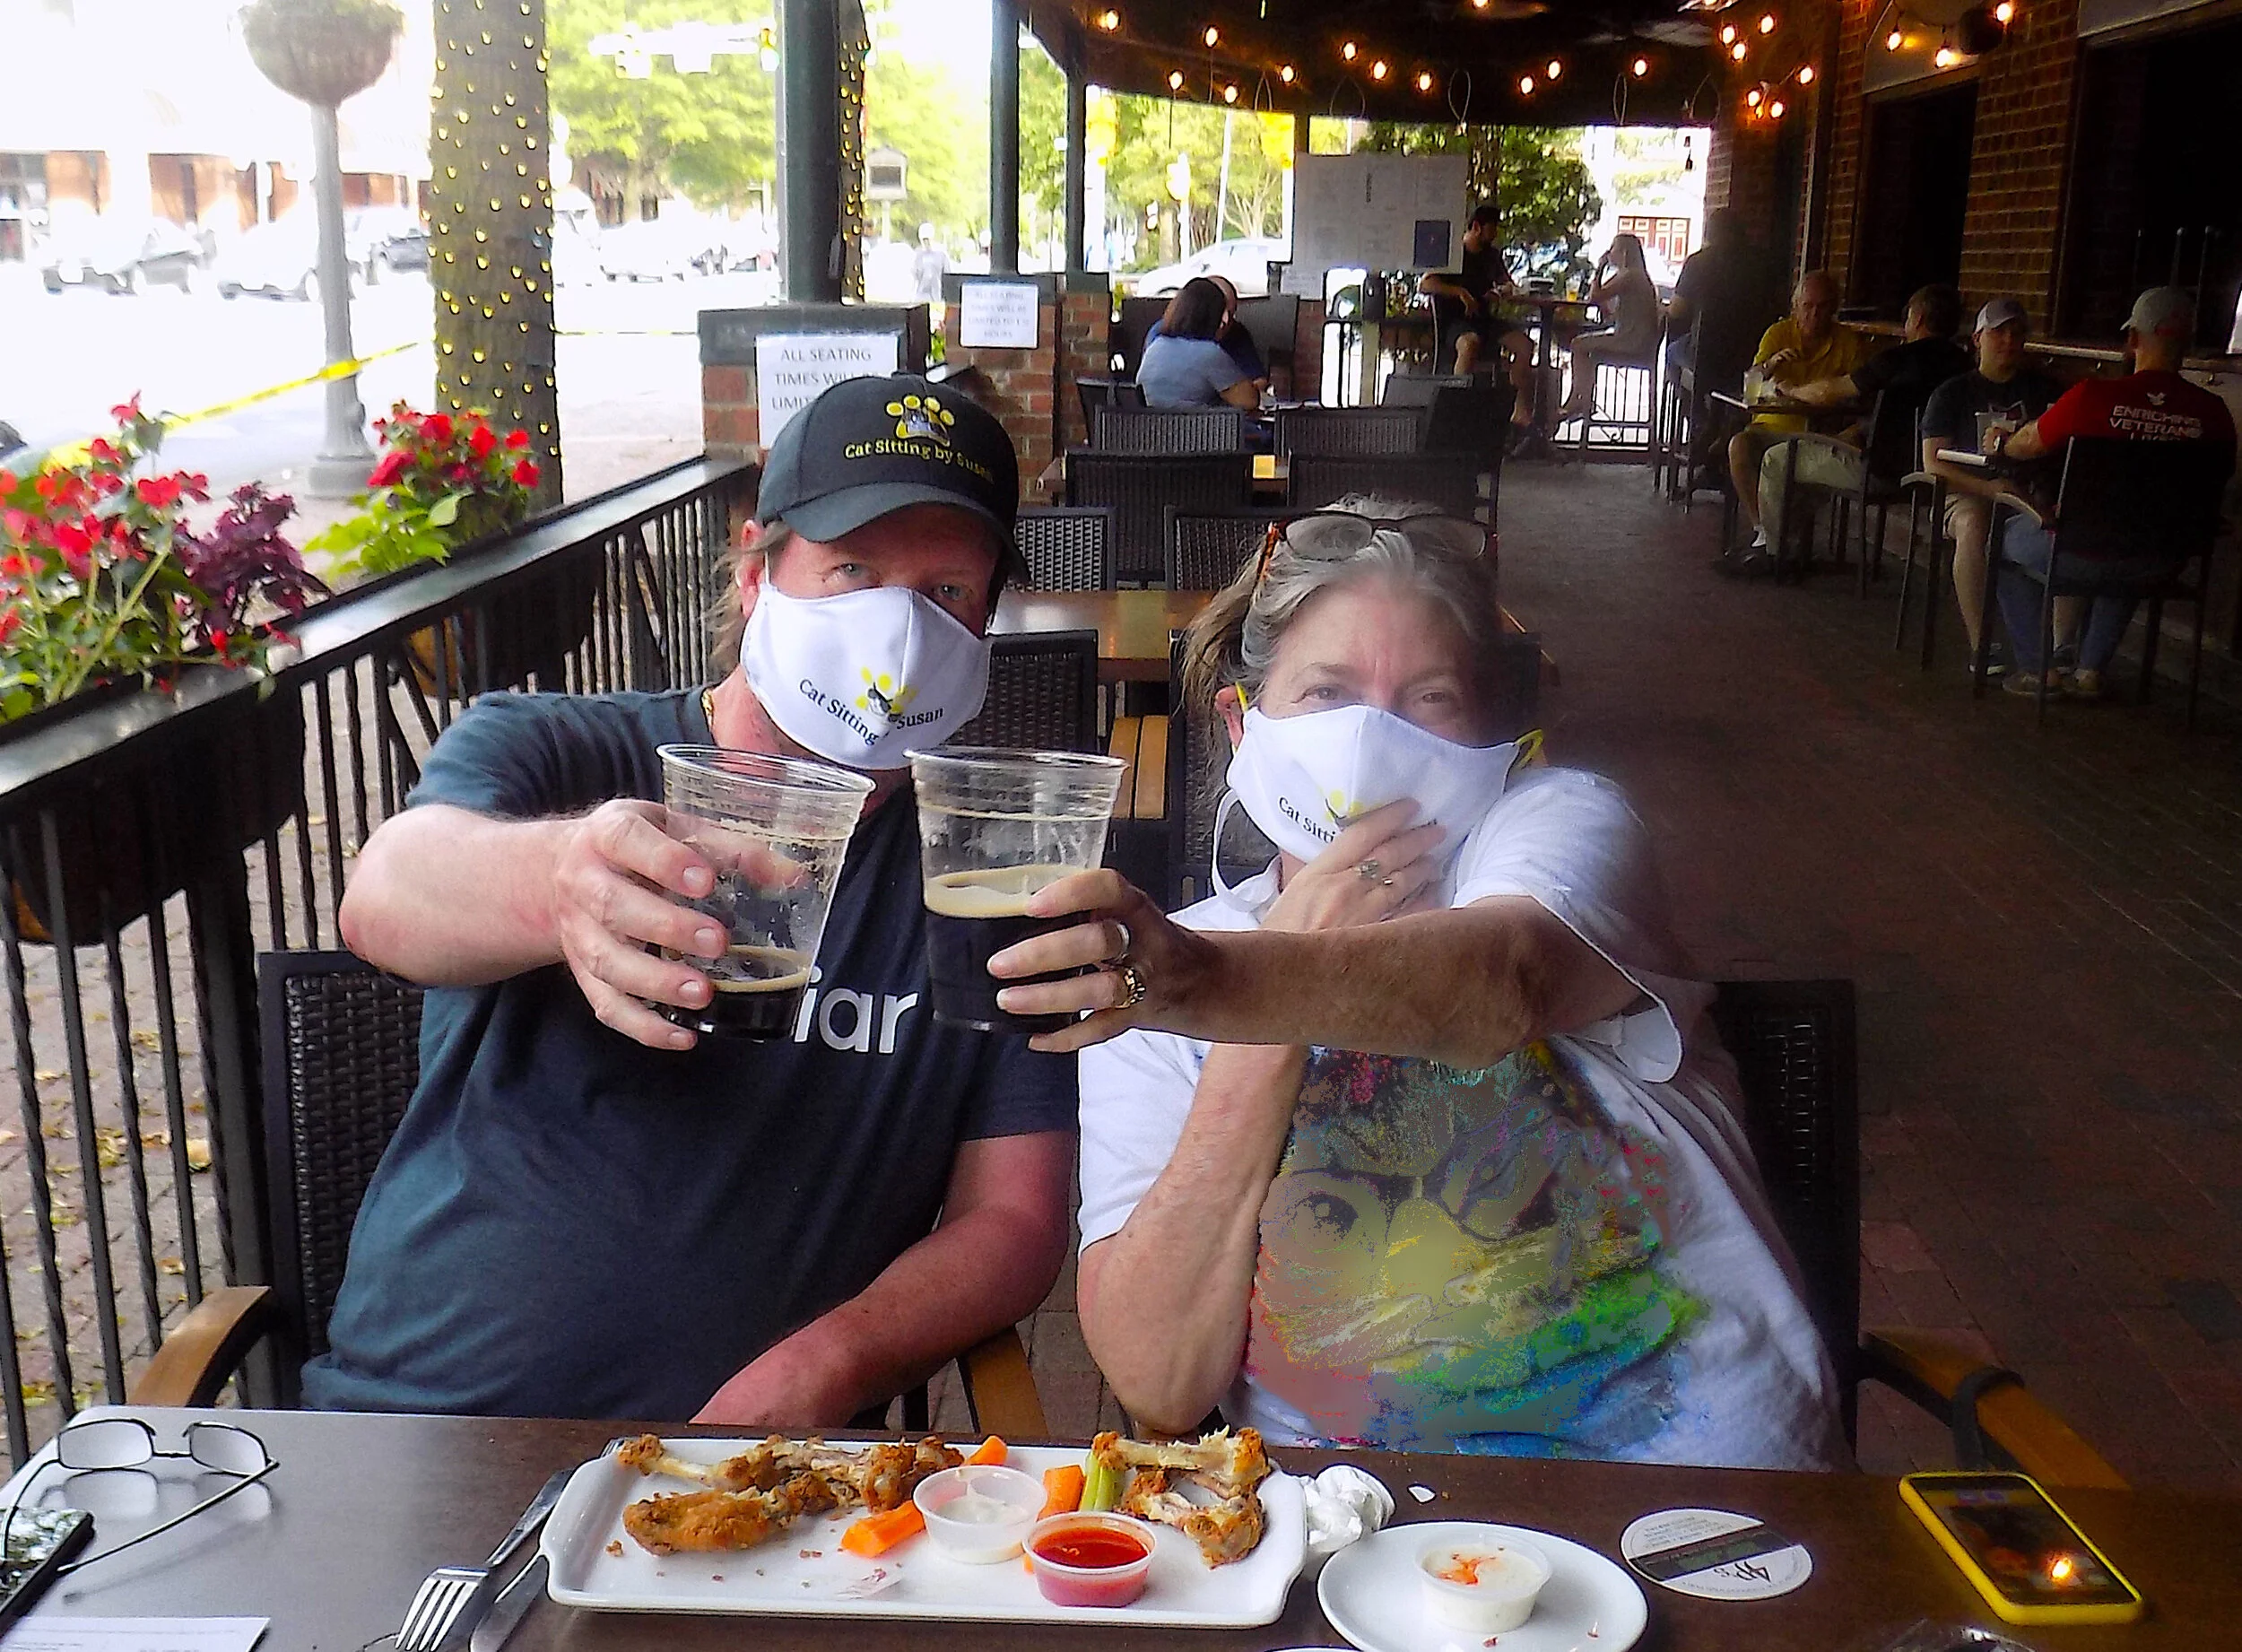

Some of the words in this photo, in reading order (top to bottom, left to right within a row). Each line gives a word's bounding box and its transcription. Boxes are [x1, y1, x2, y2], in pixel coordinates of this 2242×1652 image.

[781, 347, 805, 362] ALL
[809, 347, 873, 362] SEATING
[775, 371, 820, 387] TIMES
[821, 371, 854, 386] WI
[771, 396, 812, 411] LIMI
[845, 441, 872, 458] Cat
[875, 439, 931, 460] Sitting
[934, 445, 953, 464] by
[799, 679, 825, 707] Cat
[827, 698, 880, 746] Sitting
[1278, 796, 1300, 825] Cat
[1303, 816, 1336, 844] Sitti
